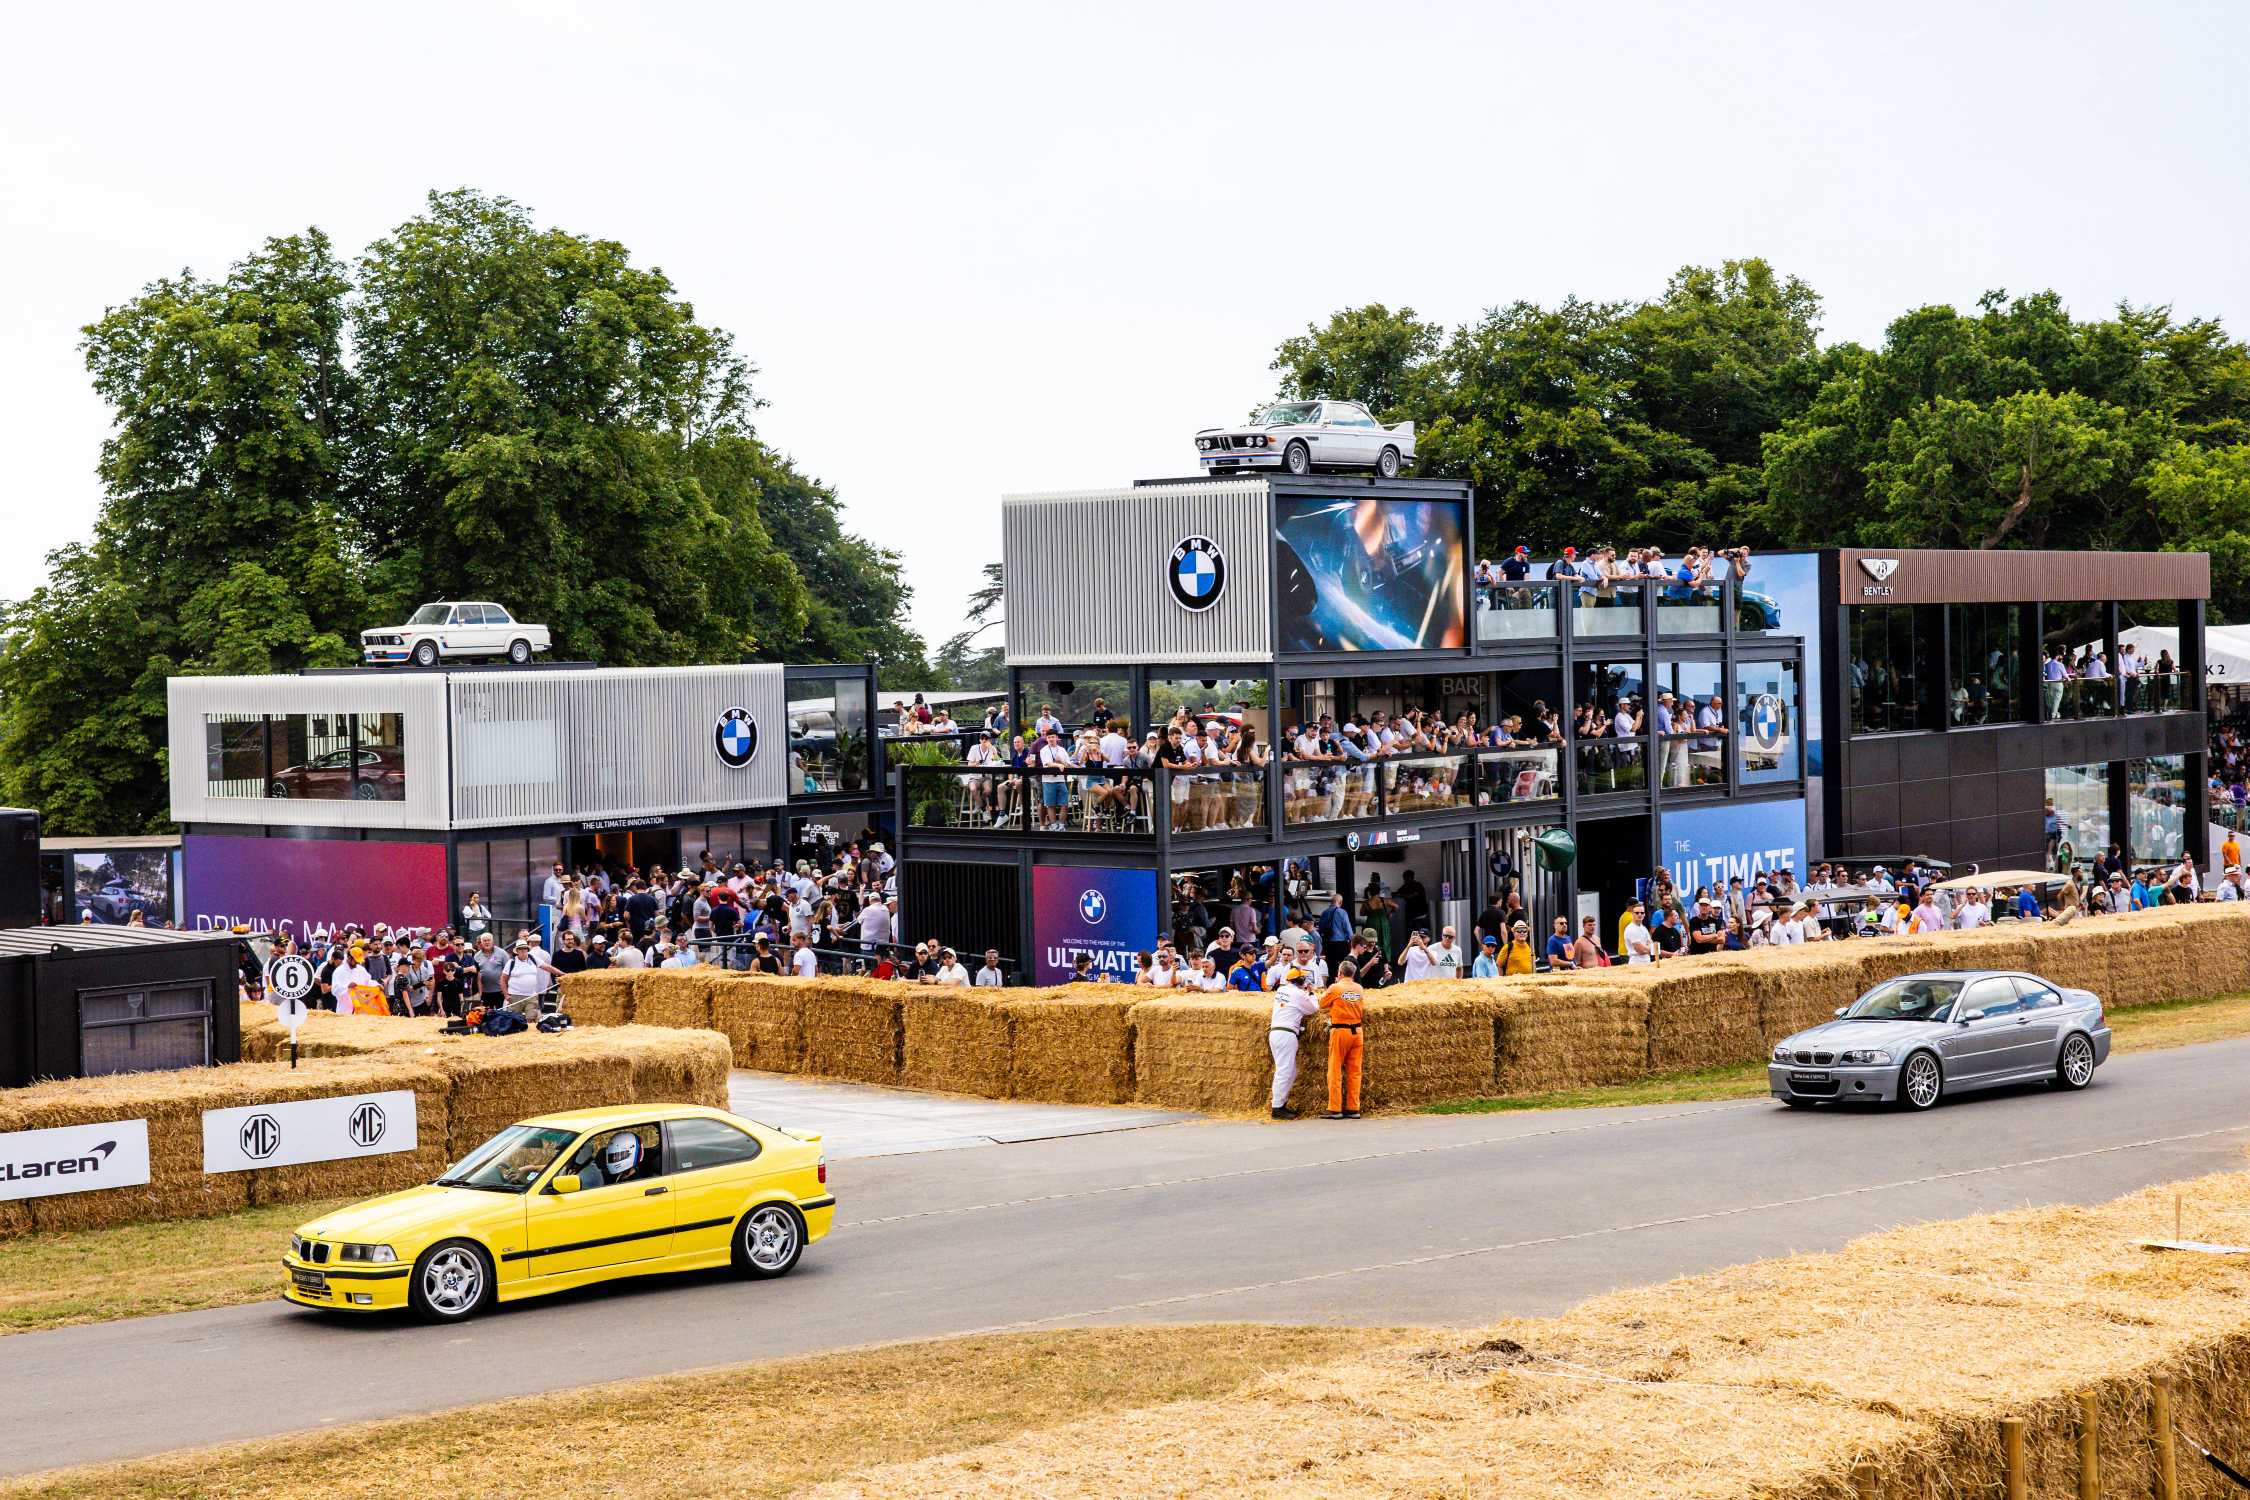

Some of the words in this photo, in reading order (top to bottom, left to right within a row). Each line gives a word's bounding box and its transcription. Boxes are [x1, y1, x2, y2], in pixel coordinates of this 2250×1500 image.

[1174, 539, 1219, 561] BMW
[1864, 586, 1894, 596] BENTLEY
[2217, 664, 2226, 675] 2
[1442, 676, 1479, 696] BAR
[720, 709, 753, 727] BMW
[582, 822, 595, 830] THE
[596, 819, 627, 829] ULTIMATE
[627, 816, 665, 827] INNOVATION
[810, 831, 839, 839] CPER
[1674, 839, 1691, 853] THE
[1047, 946, 1140, 972] ULTMATE
[286, 966, 299, 989] 6
[352, 1106, 382, 1143] MG
[244, 1118, 277, 1156] MG
[0, 1156, 99, 1182] Laren
